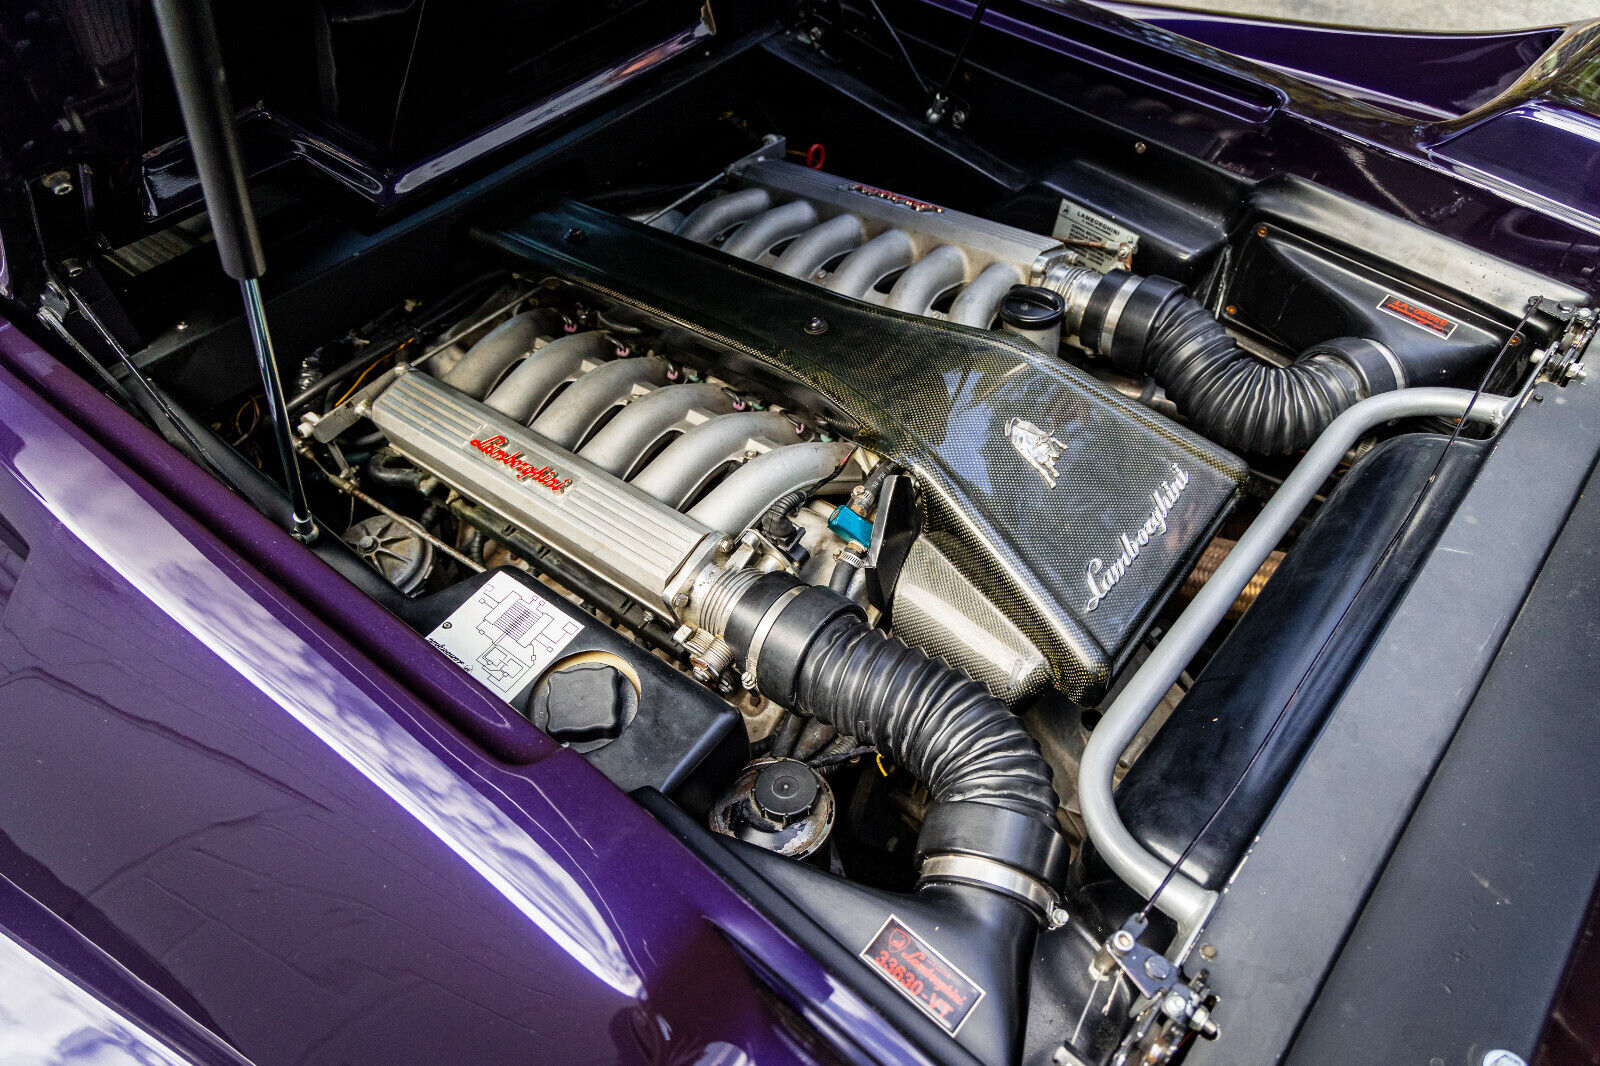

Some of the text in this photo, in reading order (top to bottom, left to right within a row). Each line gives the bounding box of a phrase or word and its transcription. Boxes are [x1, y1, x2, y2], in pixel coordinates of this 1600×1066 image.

[1077, 211, 1120, 236] LAMBORGHINI
[470, 435, 573, 493] Lamborghini
[1085, 463, 1189, 612] Lamborghini
[901, 951, 967, 1006] Lamborghini
